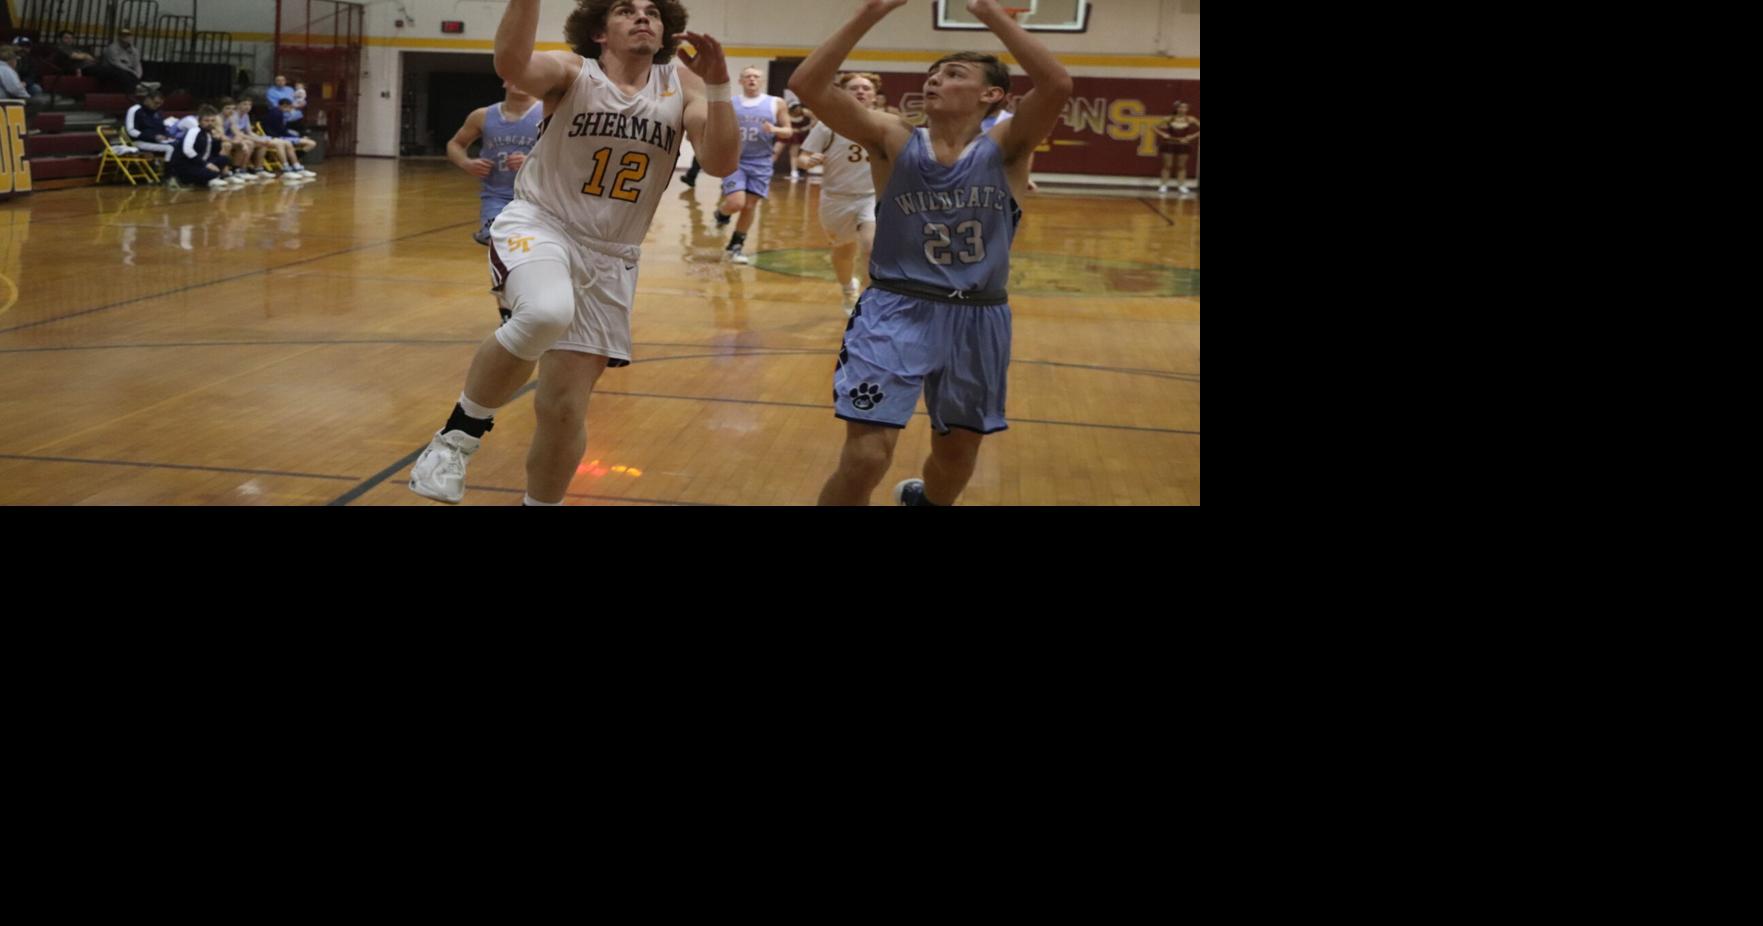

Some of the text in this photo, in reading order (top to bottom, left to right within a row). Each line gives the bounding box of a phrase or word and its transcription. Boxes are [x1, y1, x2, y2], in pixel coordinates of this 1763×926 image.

[568, 112, 676, 154] SHERMAN
[1107, 99, 1169, 157] ST
[582, 147, 650, 203] 12
[847, 144, 870, 163] 3
[894, 185, 1007, 216] WILDCATS
[922, 218, 988, 266] 23
